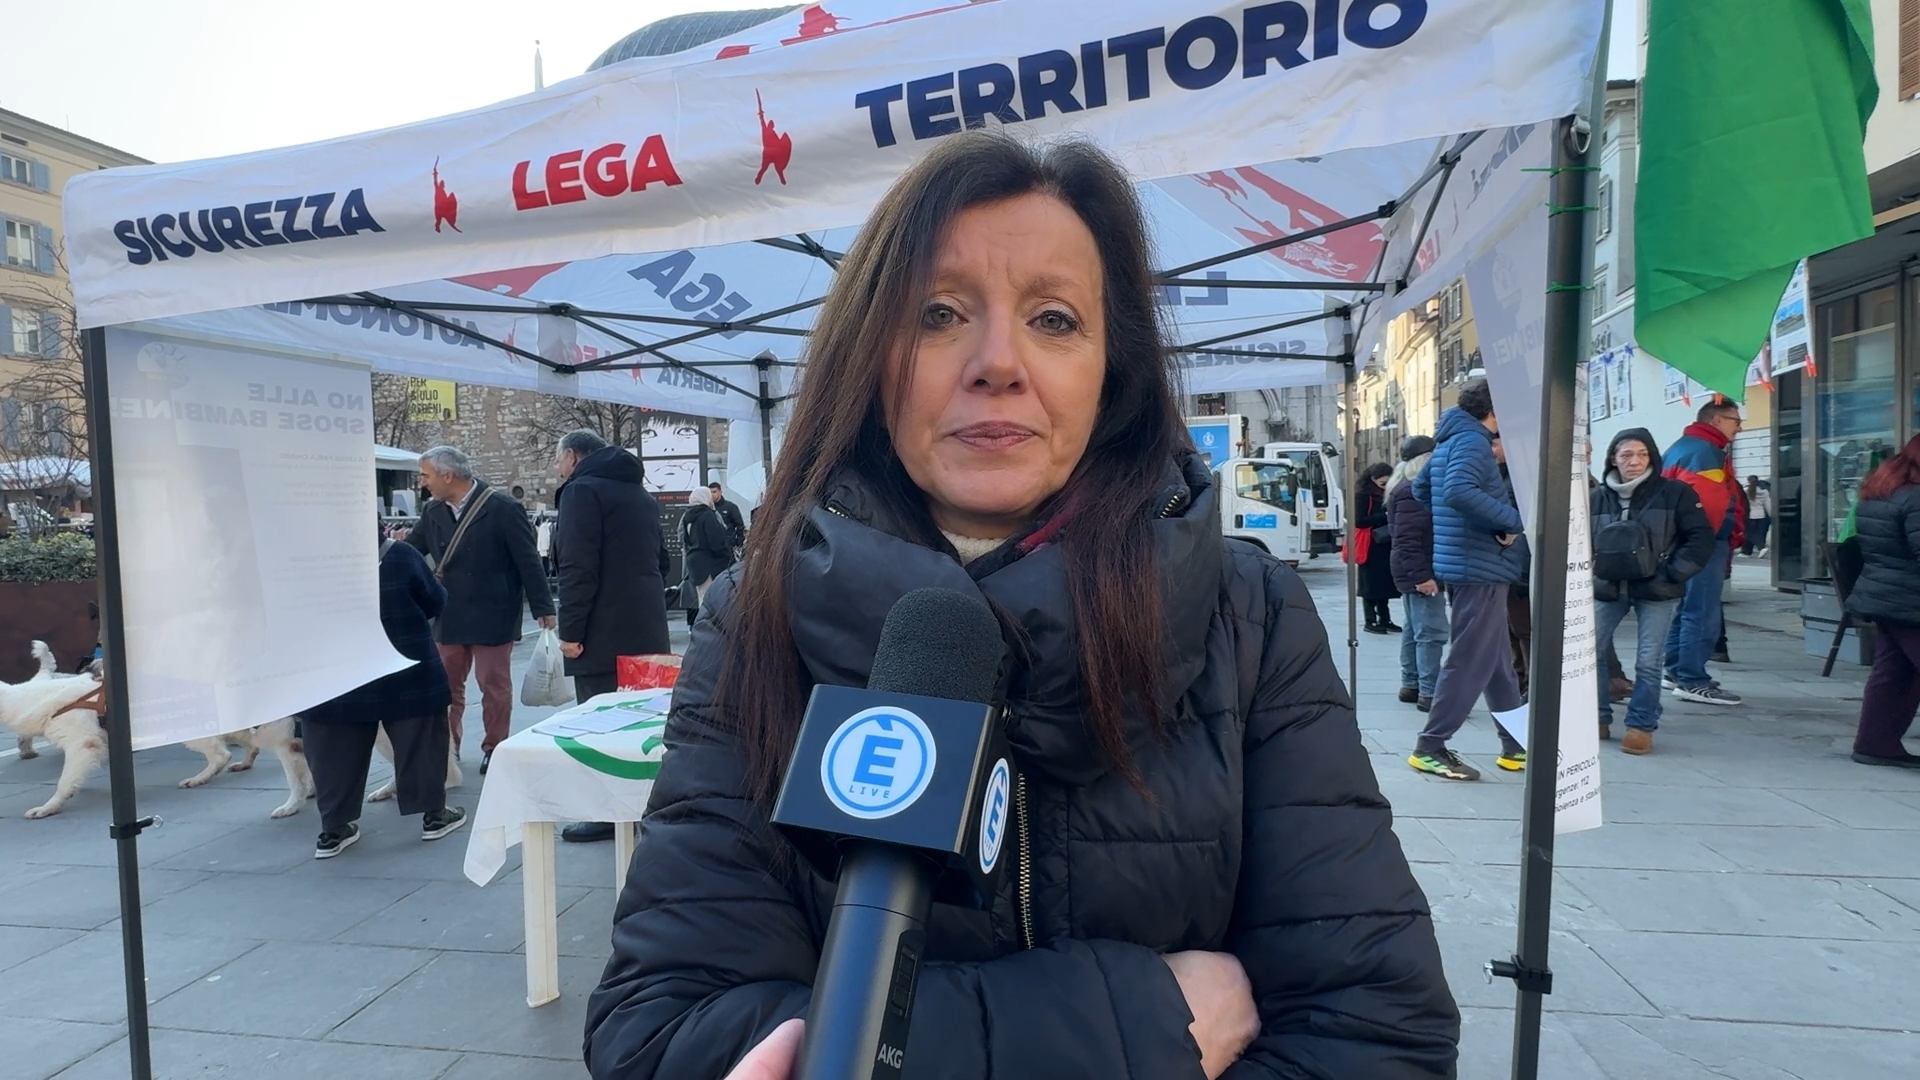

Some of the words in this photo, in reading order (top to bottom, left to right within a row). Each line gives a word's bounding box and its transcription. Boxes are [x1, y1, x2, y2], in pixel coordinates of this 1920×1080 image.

[114, 188, 386, 265] SICUREZZA
[512, 134, 684, 211] LEGA
[855, 0, 1428, 148] TERRITORIO
[852, 719, 904, 787] È
[849, 785, 890, 798] LIVE
[877, 1043, 903, 1069] AKG
